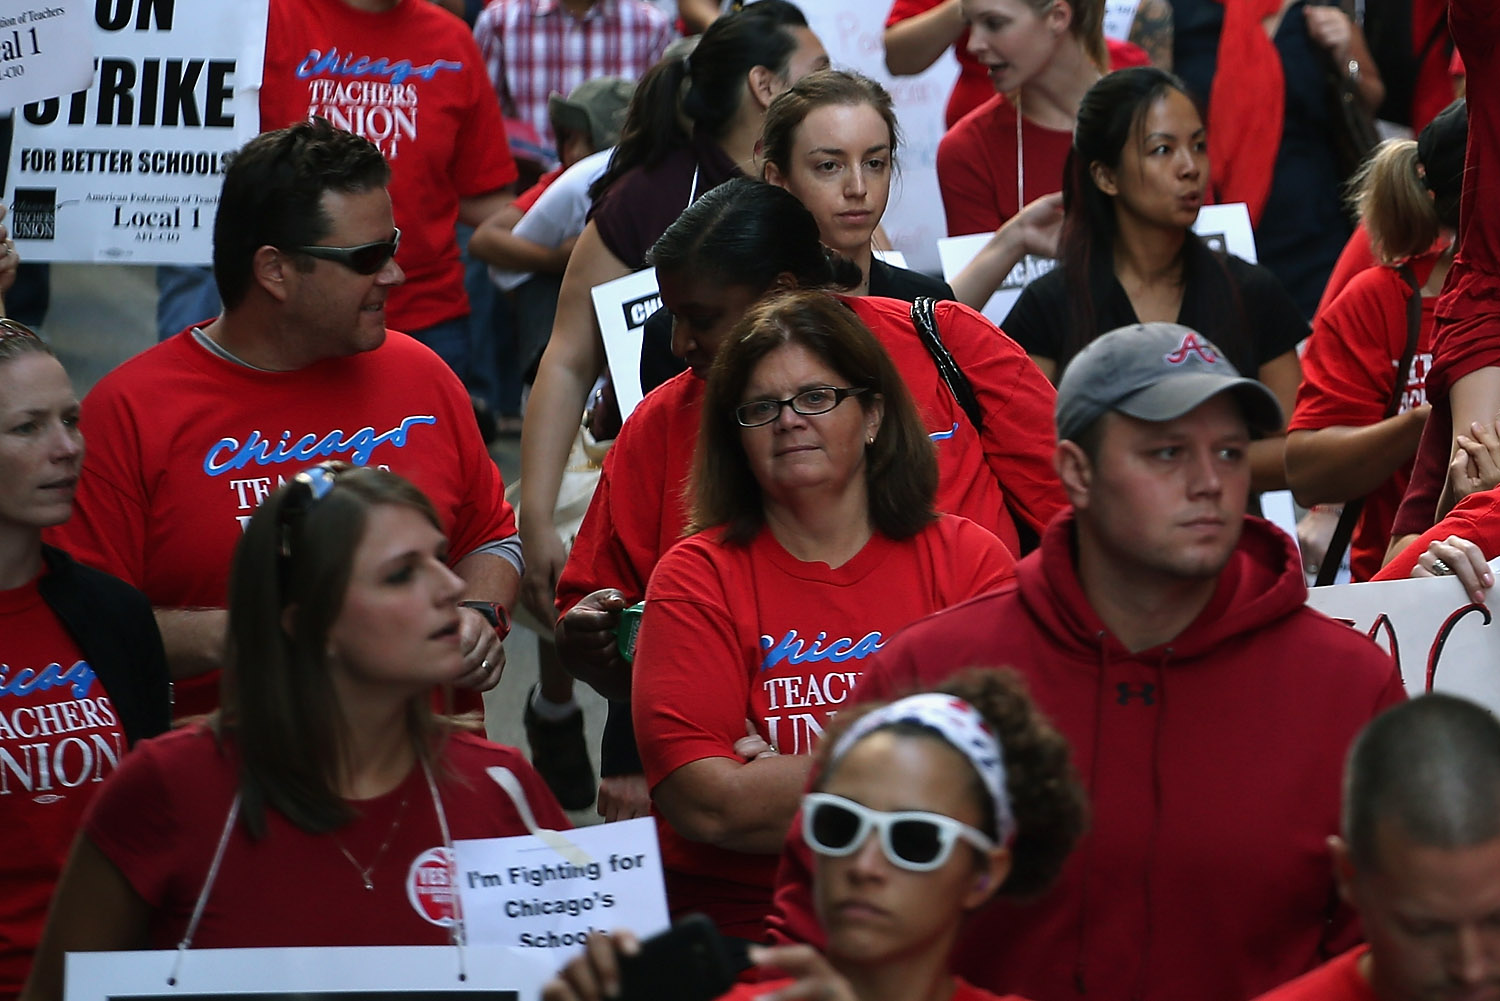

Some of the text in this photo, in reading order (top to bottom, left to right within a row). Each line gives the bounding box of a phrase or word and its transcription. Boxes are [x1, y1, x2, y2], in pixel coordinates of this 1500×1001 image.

[28, 6, 65, 22] Teachers
[0, 27, 42, 62] cal 1
[296, 47, 463, 85] Chicago
[308, 78, 418, 106] TEACHERS
[20, 148, 57, 173] FOR
[61, 149, 133, 174] BETTER
[85, 191, 127, 202] American
[113, 206, 200, 229] Local 1
[203, 415, 437, 477] Chicago
[761, 629, 888, 672] hica
[763, 671, 864, 711] TEAC
[0, 696, 118, 740] ACHERS
[0, 732, 122, 795] NION
[467, 853, 646, 889] I'm Fighting for
[505, 892, 615, 918] Chicago's
[519, 926, 608, 949] Schoo
